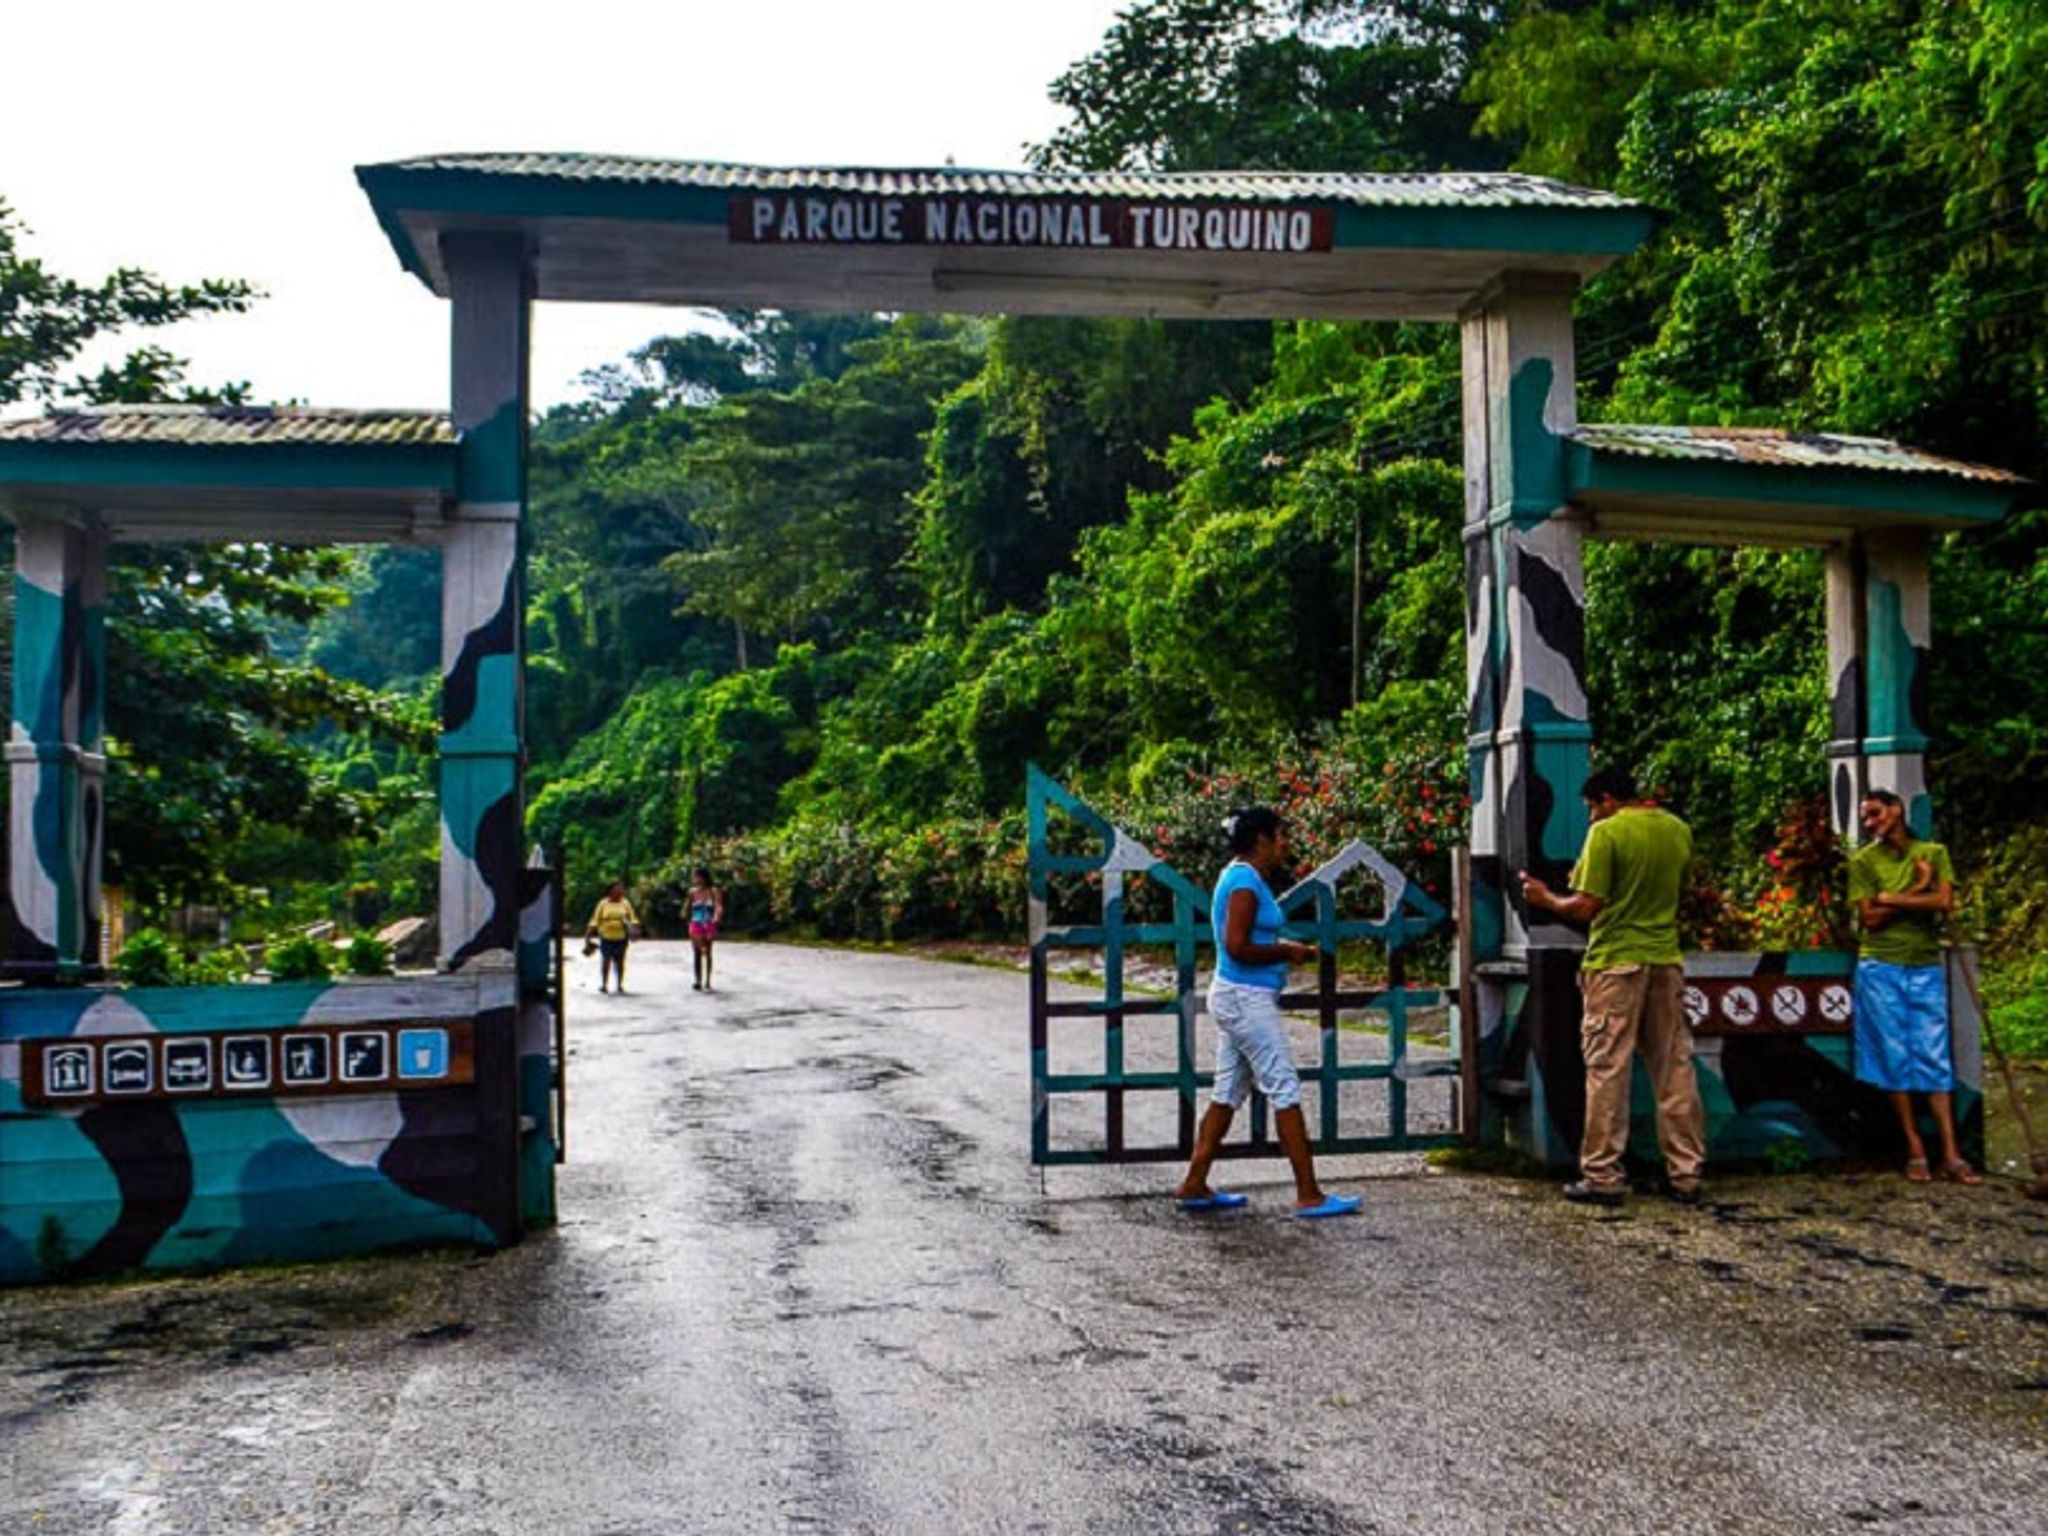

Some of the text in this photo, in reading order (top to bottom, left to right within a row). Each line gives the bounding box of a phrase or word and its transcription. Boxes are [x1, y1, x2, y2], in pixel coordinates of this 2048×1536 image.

[752, 199, 1311, 252] PARQUE NACIONAL TURQUINO
